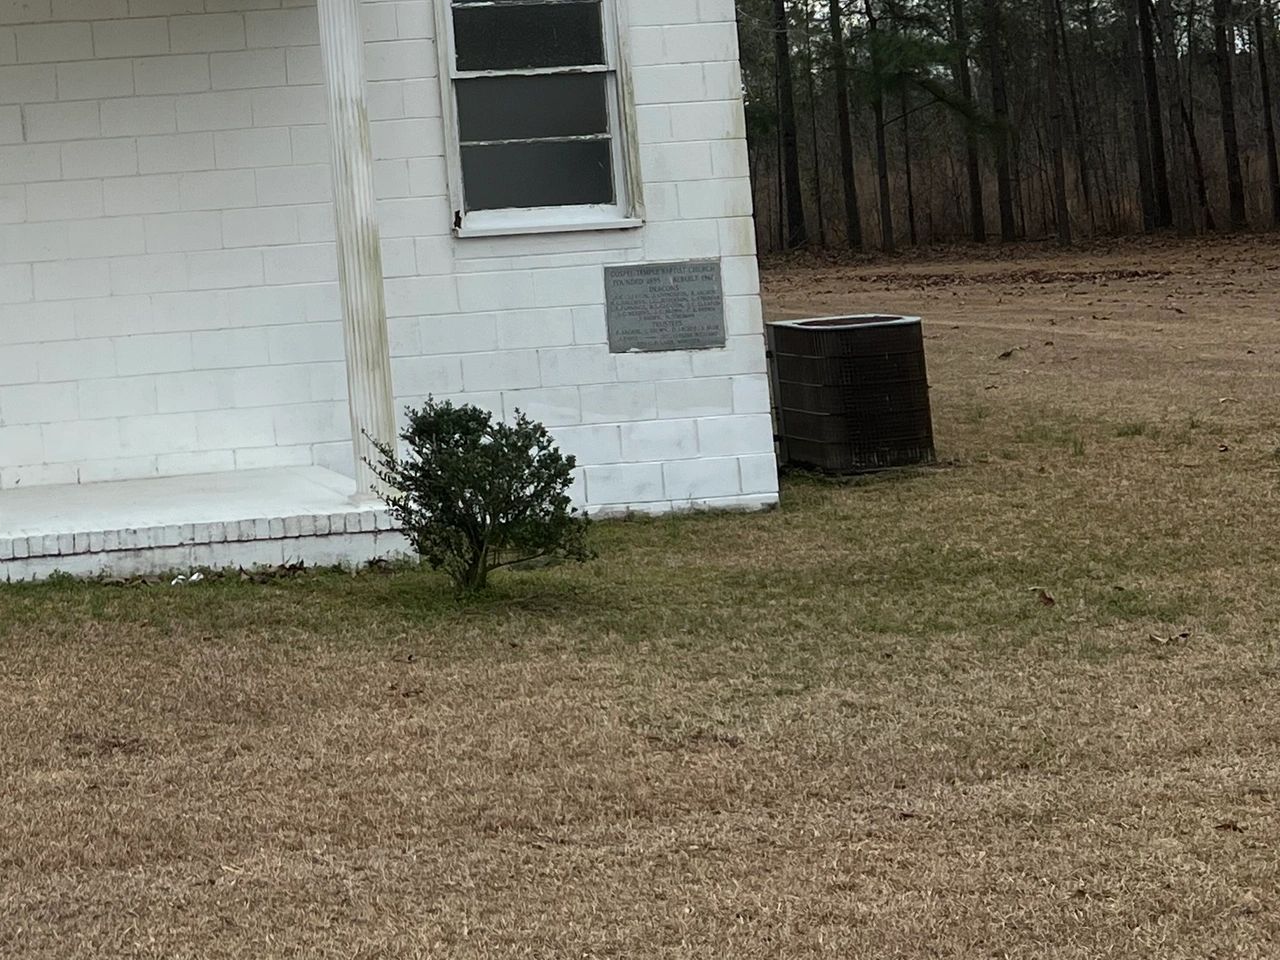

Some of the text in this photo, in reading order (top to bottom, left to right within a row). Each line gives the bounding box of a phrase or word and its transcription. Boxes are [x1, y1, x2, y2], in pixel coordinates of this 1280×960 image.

[636, 269, 659, 277] TEMPLE
[688, 265, 715, 273] CHURCH
[612, 278, 644, 286] FOUNDED
[672, 275, 698, 283] REBUILT
[649, 284, 680, 293] DEACONS
